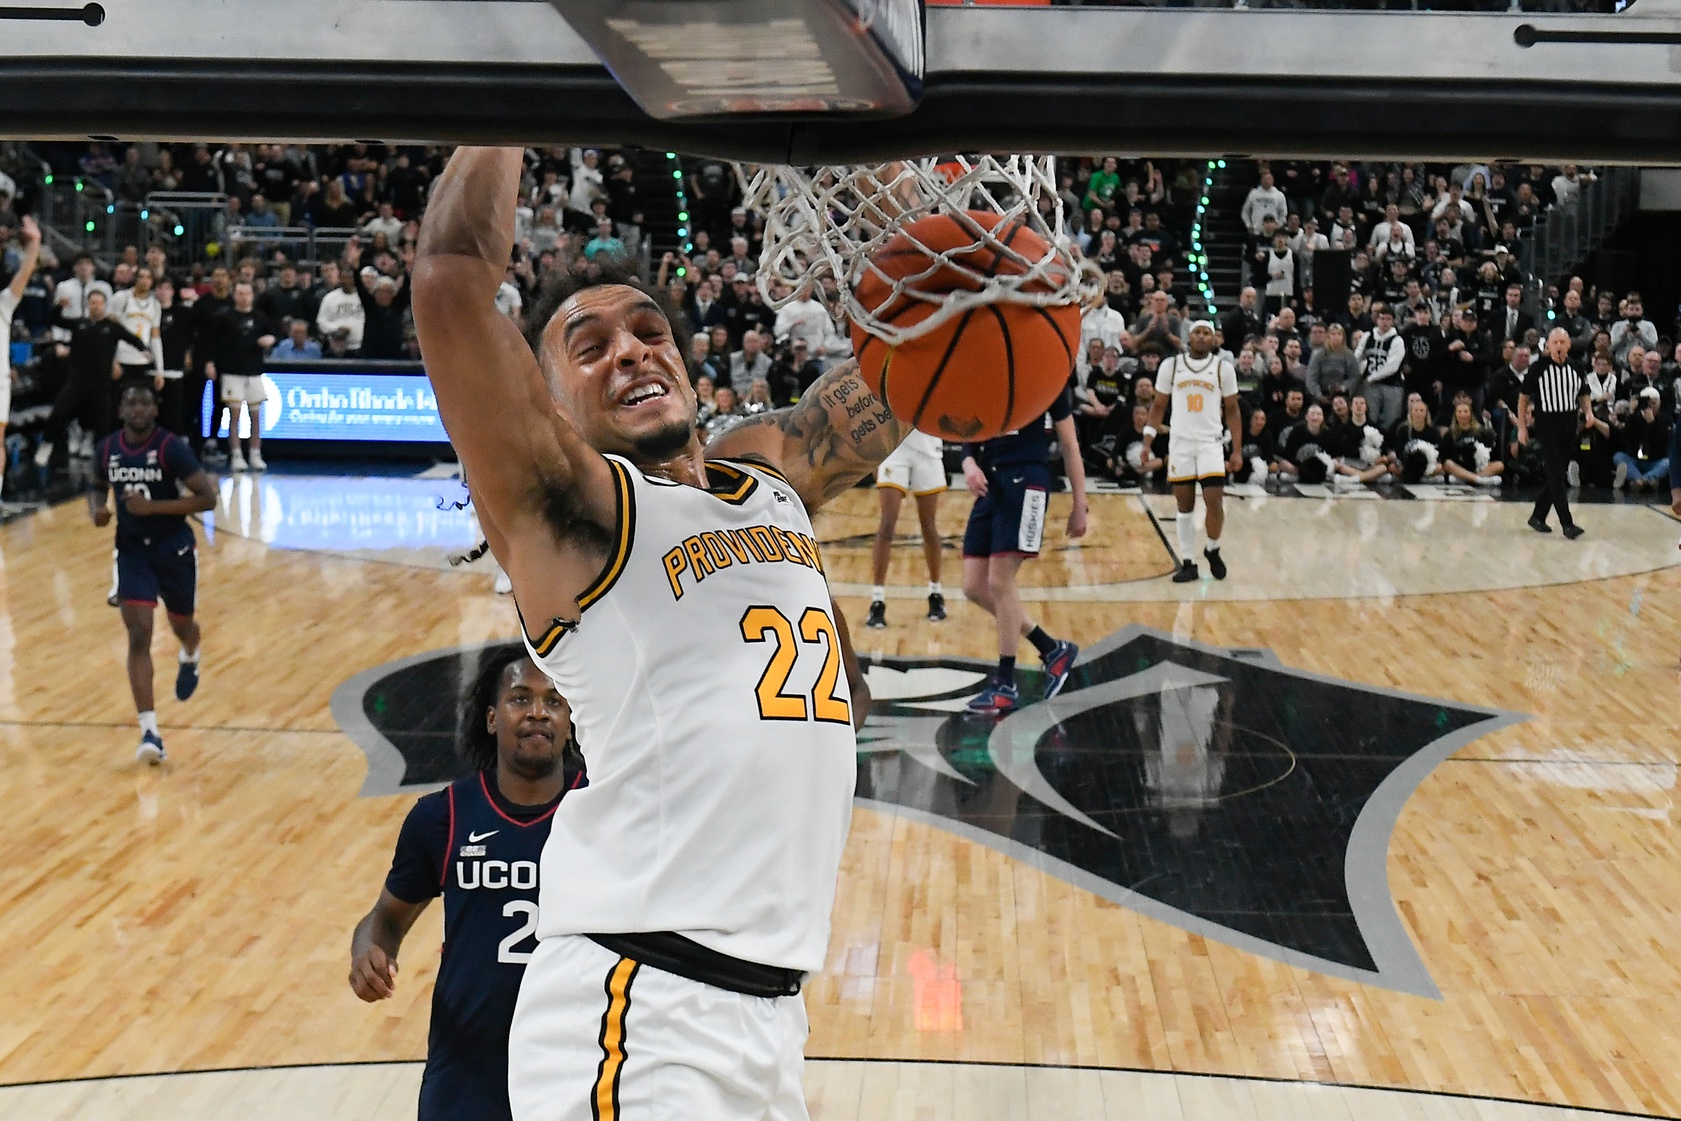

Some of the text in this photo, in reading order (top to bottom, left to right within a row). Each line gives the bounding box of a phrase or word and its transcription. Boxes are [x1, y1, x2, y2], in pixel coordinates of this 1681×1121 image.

[287, 386, 349, 409] Ortho
[349, 387, 415, 410] Rhode
[833, 378, 860, 404] gets
[846, 393, 878, 419] befor
[1187, 394, 1204, 413] 10
[851, 408, 893, 444] gets be
[108, 466, 163, 482] UCONN
[1026, 495, 1040, 548] HUSKIES
[662, 525, 824, 602] PROVIDEN
[739, 604, 851, 726] 22
[456, 860, 537, 890] UCO
[497, 899, 540, 964] 2
